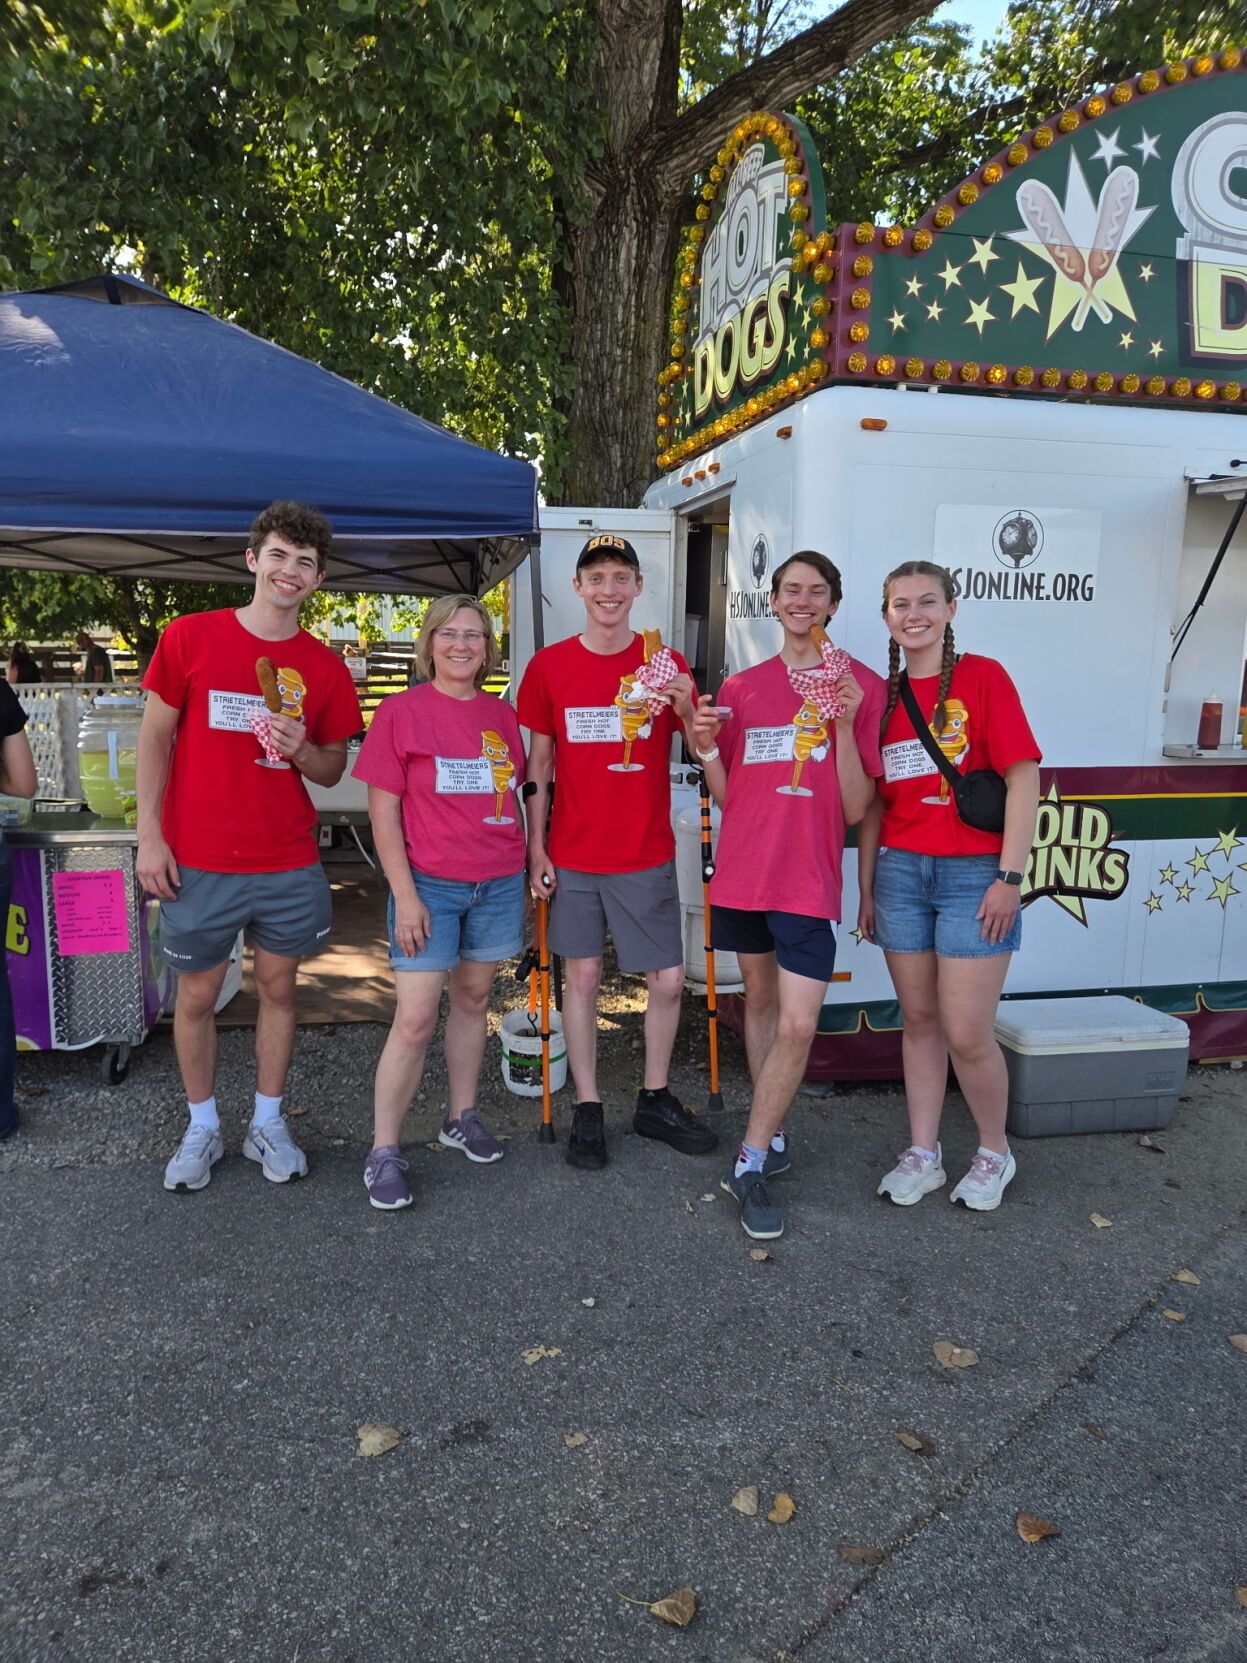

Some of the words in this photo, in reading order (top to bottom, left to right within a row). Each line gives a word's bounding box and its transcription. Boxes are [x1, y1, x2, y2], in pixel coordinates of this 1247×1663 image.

[702, 158, 788, 331] HOT
[694, 260, 791, 417] DOGS
[588, 536, 625, 551] BOS
[945, 567, 1094, 602] SJONLINE.ORG
[222, 704, 246, 712] FRESH
[1032, 804, 1109, 849] OLD
